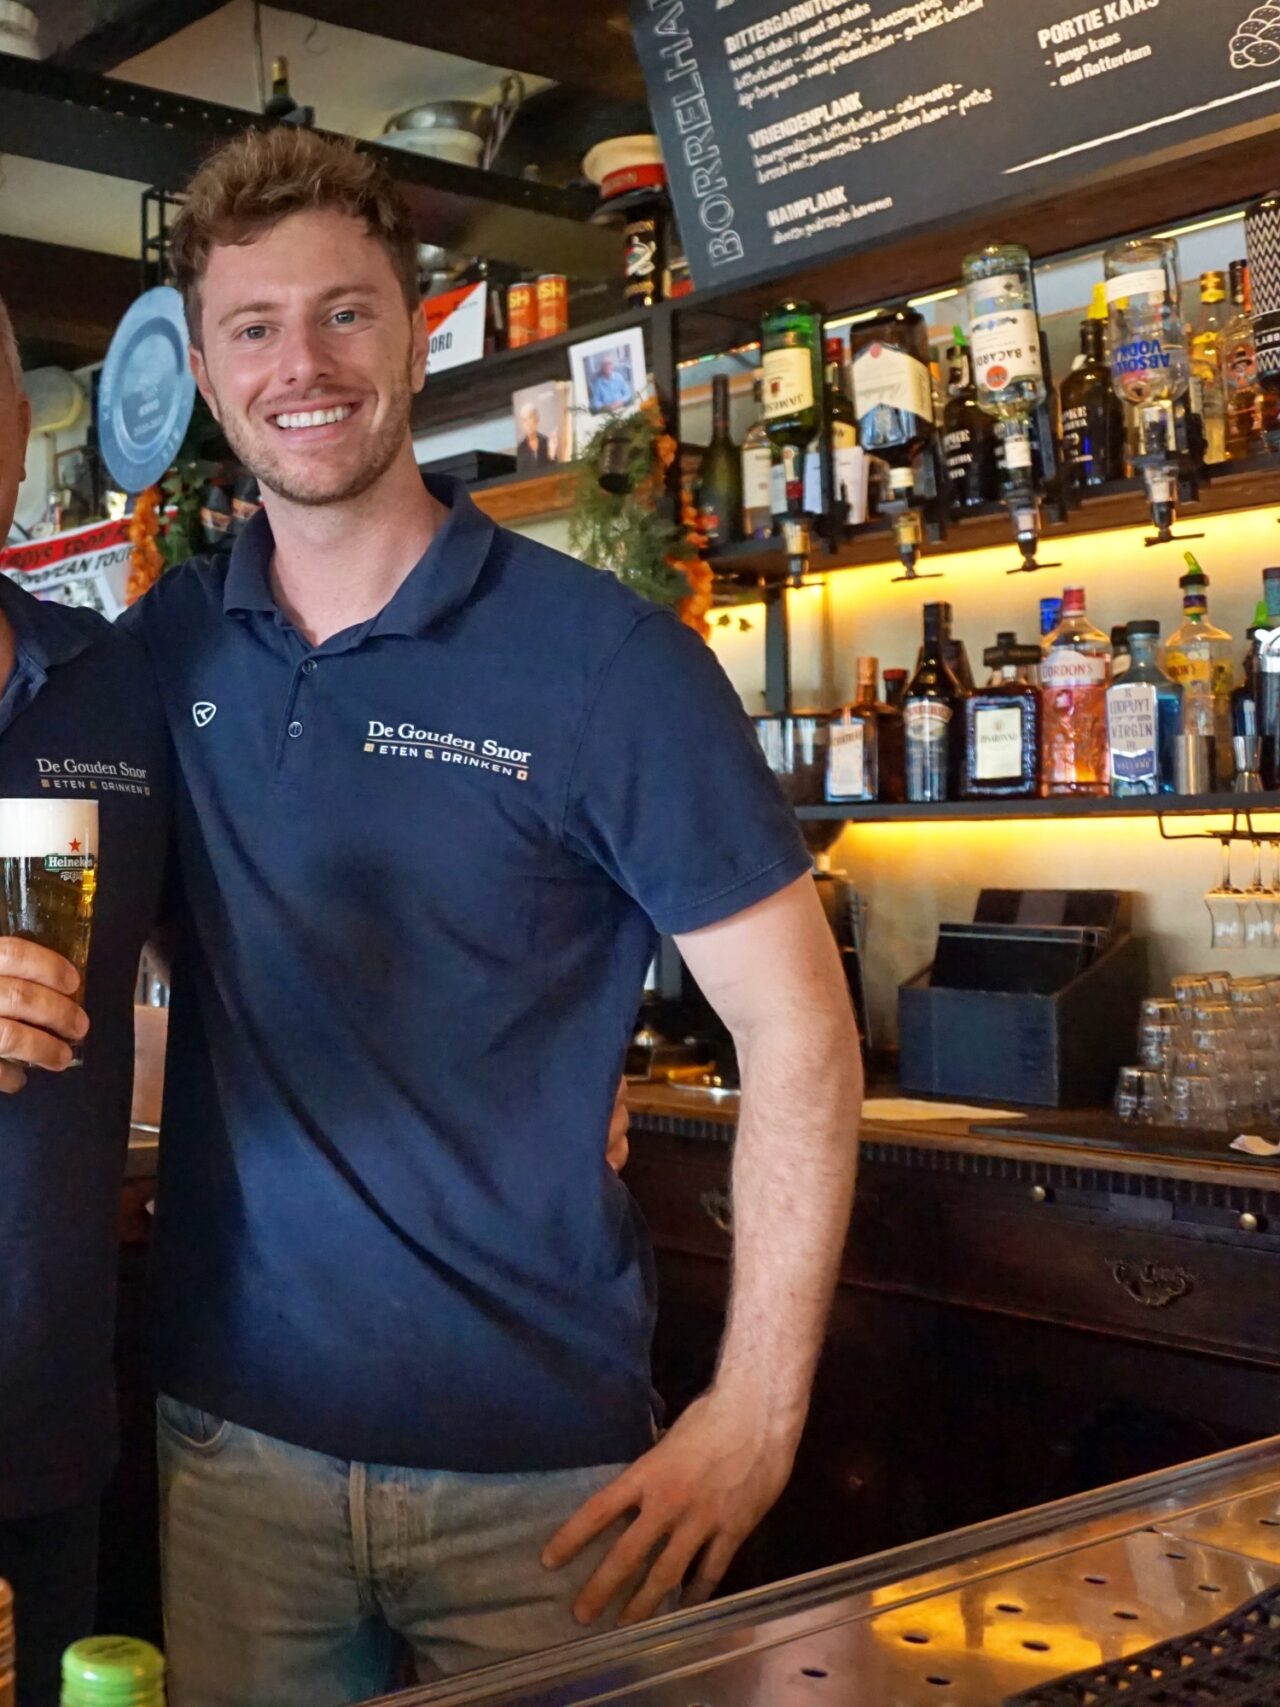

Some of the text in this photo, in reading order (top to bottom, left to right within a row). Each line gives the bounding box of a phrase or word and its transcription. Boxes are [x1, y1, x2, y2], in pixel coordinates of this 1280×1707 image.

[729, 52, 754, 71] klein
[764, 35, 793, 55] stuks
[798, 19, 826, 43] groot
[824, 13, 841, 28] 30
[839, 1, 871, 23] stuks
[1037, 8, 1104, 49] PORTIE
[1054, 45, 1088, 67] jonge
[1088, 32, 1121, 51] kaas
[1059, 66, 1083, 87] oud
[1083, 45, 1152, 78] Rotterdam
[649, 0, 744, 267] BORRELHA
[748, 91, 863, 149] VRIENDENPLANK
[766, 185, 848, 228] HAMPLANK
[368, 721, 532, 763] De Gouden Snor
[1111, 723, 1152, 740] VIRGIN
[35, 758, 147, 779] De Gouden Snor
[379, 745, 418, 757] ETEN
[441, 751, 513, 776] DRINKEN
[53, 779, 86, 789] ETEN
[101, 781, 143, 795] DRINKEN
